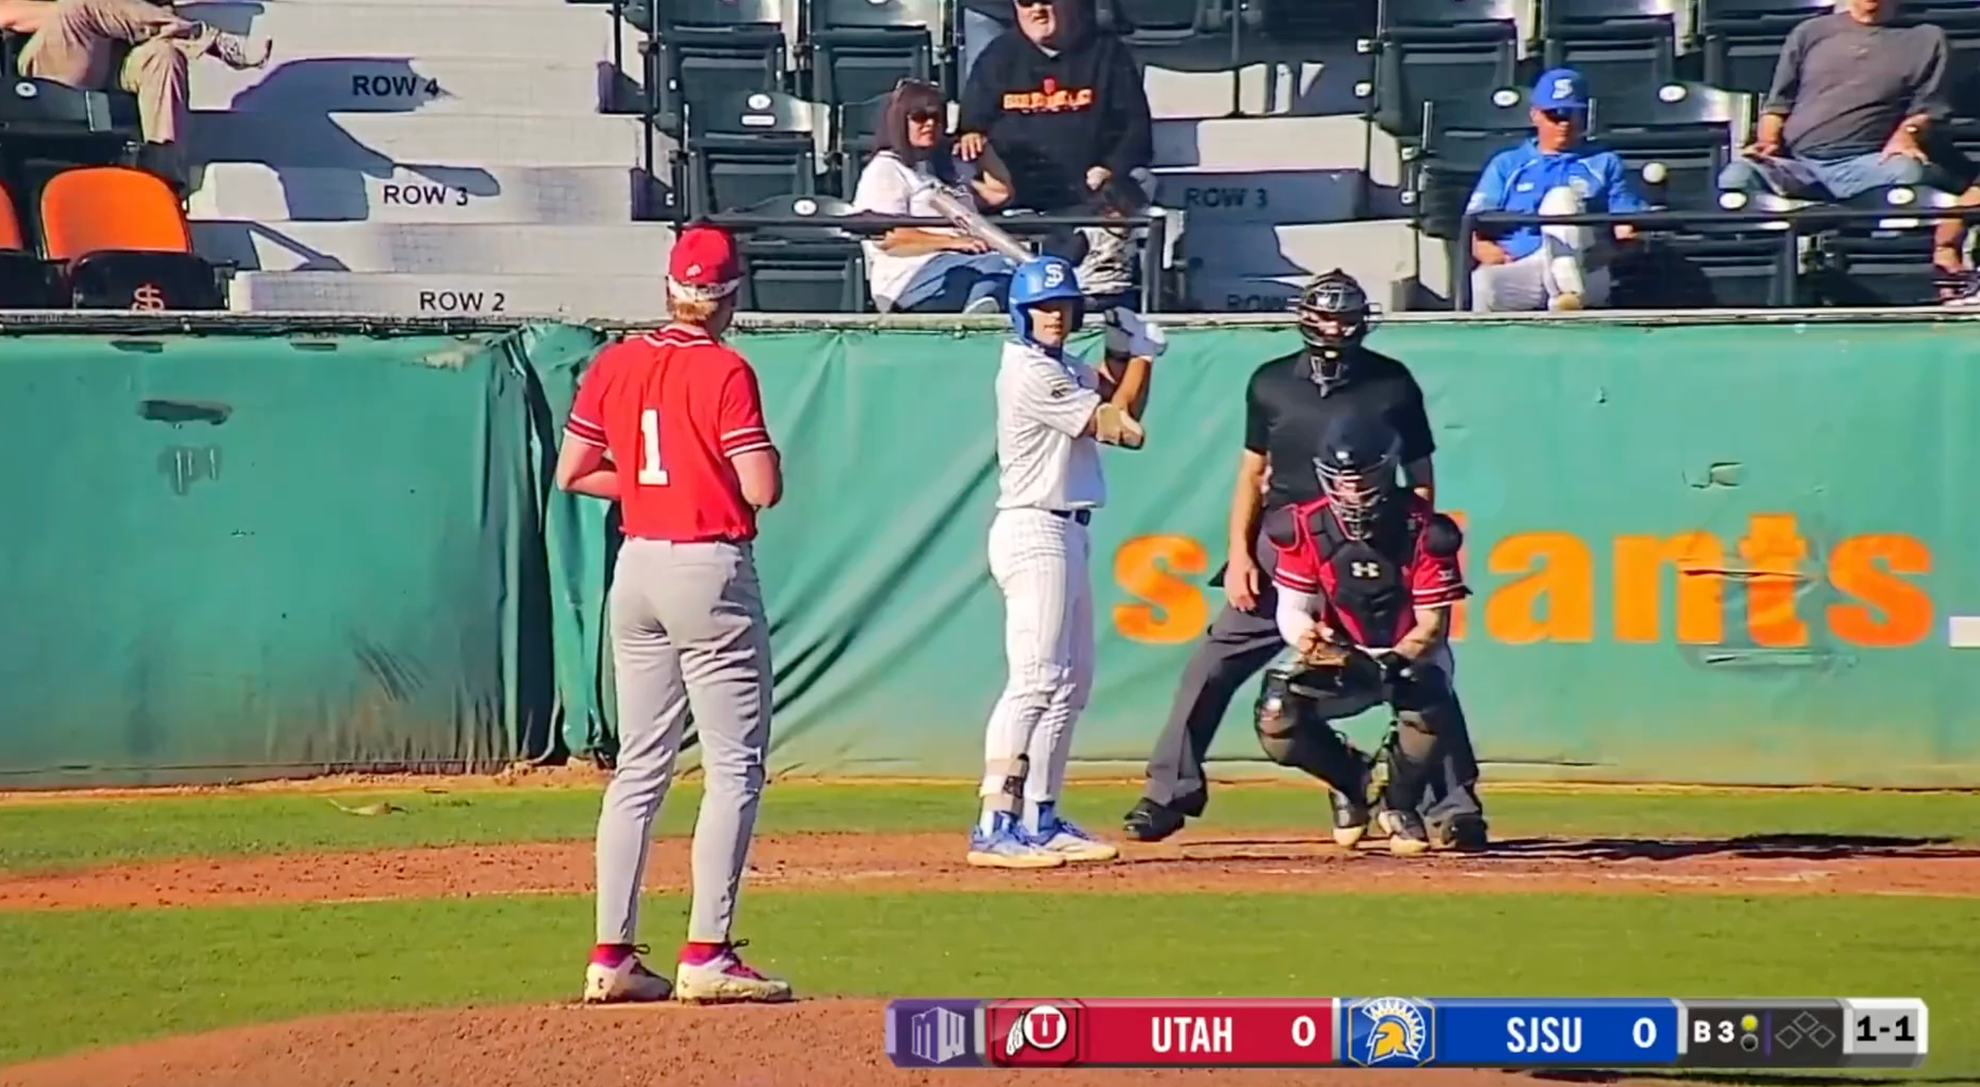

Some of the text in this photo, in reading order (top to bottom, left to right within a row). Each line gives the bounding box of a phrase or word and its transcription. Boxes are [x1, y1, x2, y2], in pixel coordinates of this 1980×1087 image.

[352, 75, 439, 97] ROW 4
[384, 185, 468, 206] ROW 3
[1185, 187, 1268, 208] ROW 3
[420, 291, 505, 312] ROW 2
[639, 409, 668, 486] 1
